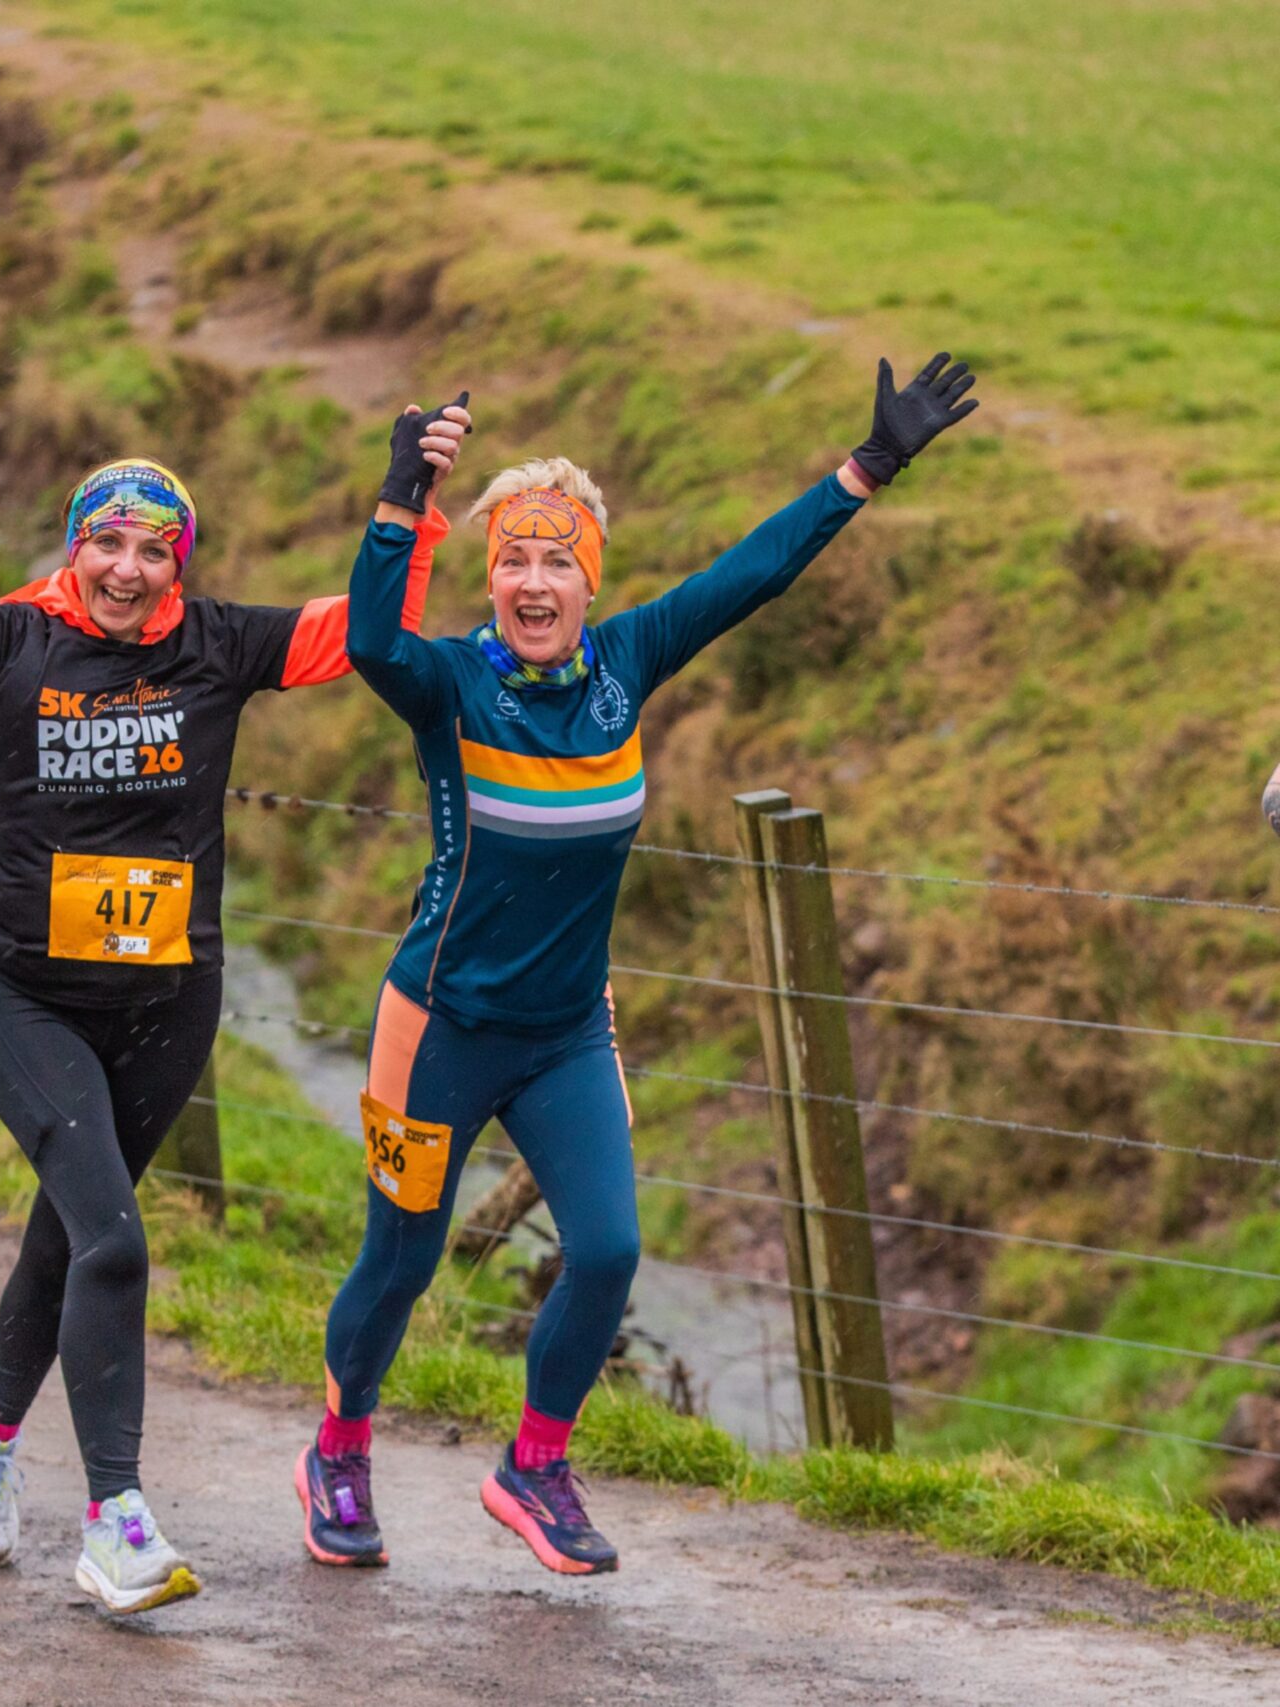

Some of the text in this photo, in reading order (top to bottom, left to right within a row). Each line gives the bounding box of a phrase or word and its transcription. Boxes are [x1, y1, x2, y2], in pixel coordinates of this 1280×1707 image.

[38, 687, 87, 718] 5K
[38, 710, 185, 750] PUDDIN'
[38, 742, 184, 780] RACE 26
[37, 777, 188, 794] DUNNING, SCOTLAND
[127, 868, 152, 885] 5K
[96, 889, 158, 926] 417
[368, 1125, 406, 1174] 456
